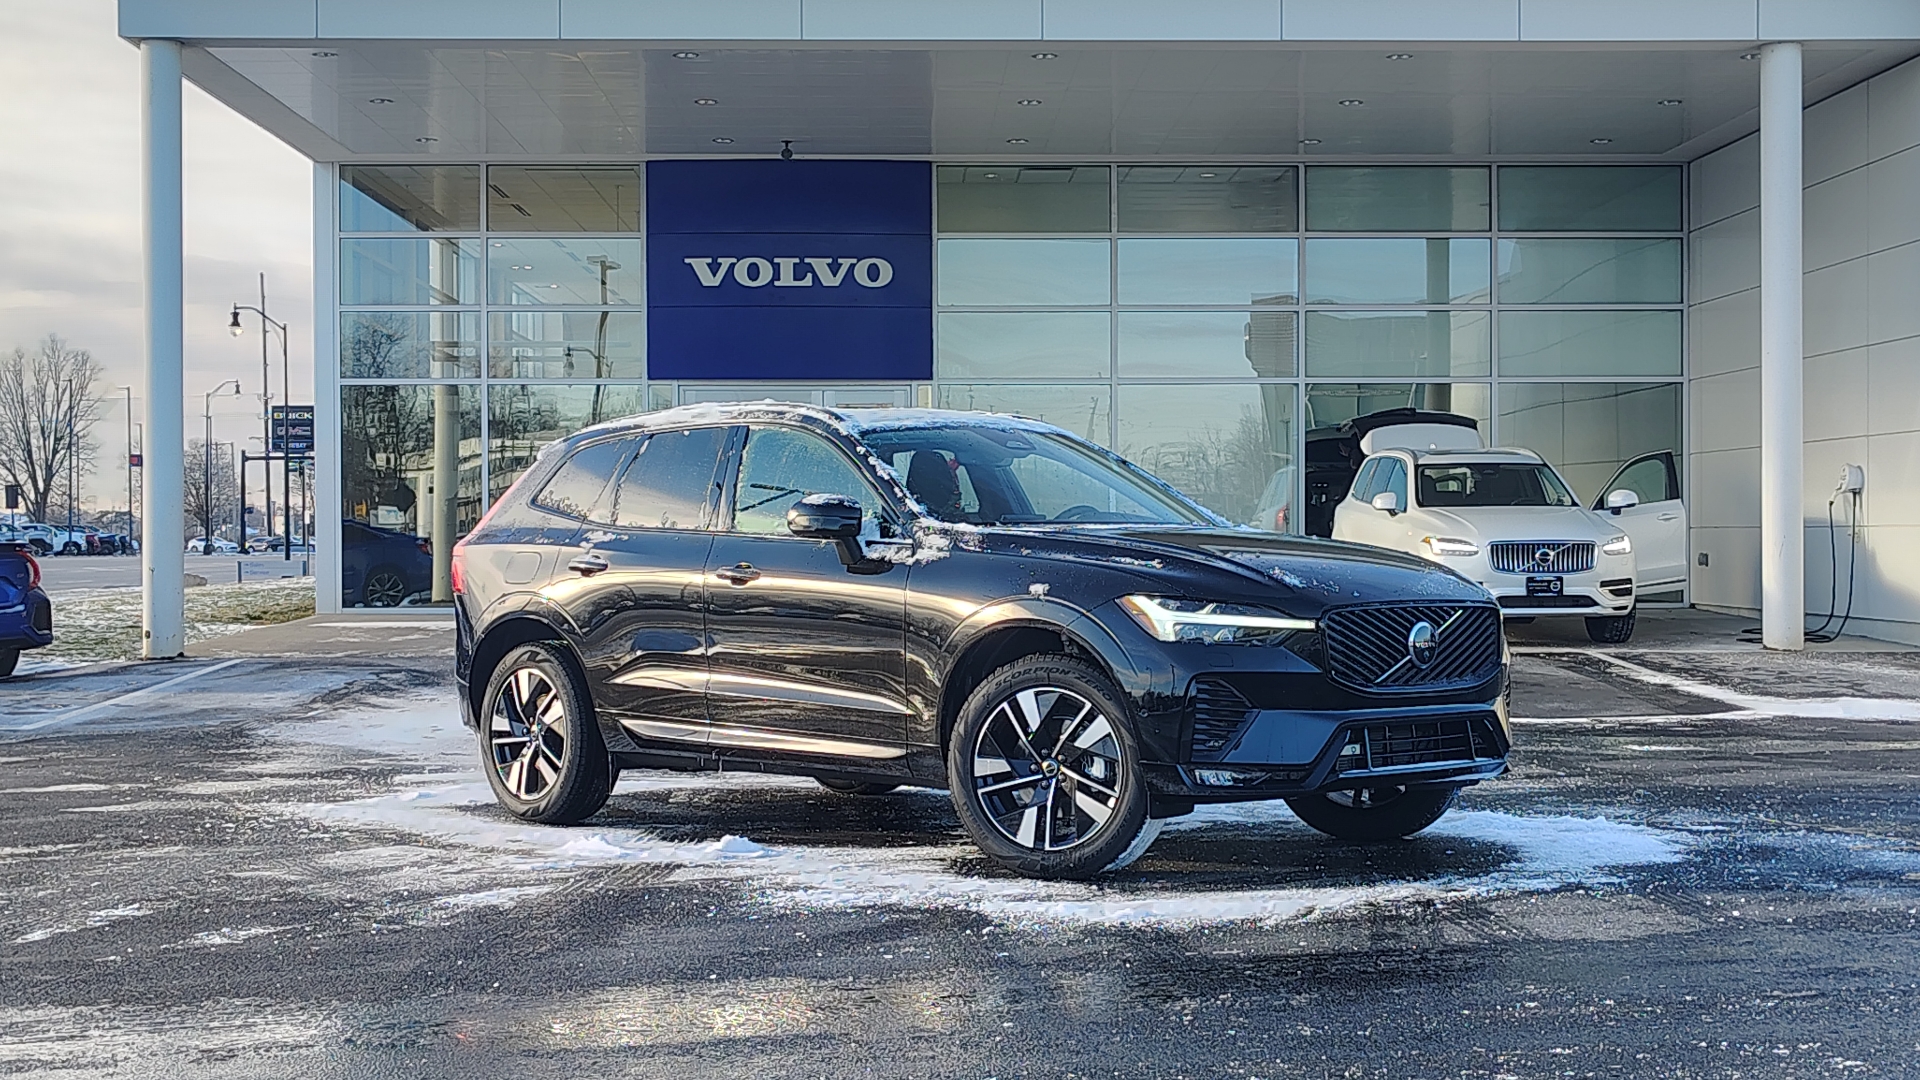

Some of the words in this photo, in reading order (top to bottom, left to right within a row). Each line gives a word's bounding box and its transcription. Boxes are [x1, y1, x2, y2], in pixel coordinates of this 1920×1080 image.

[684, 256, 894, 288] VOLVO
[994, 665, 1072, 692] SCORPION
[1073, 671, 1113, 702] ZERO
